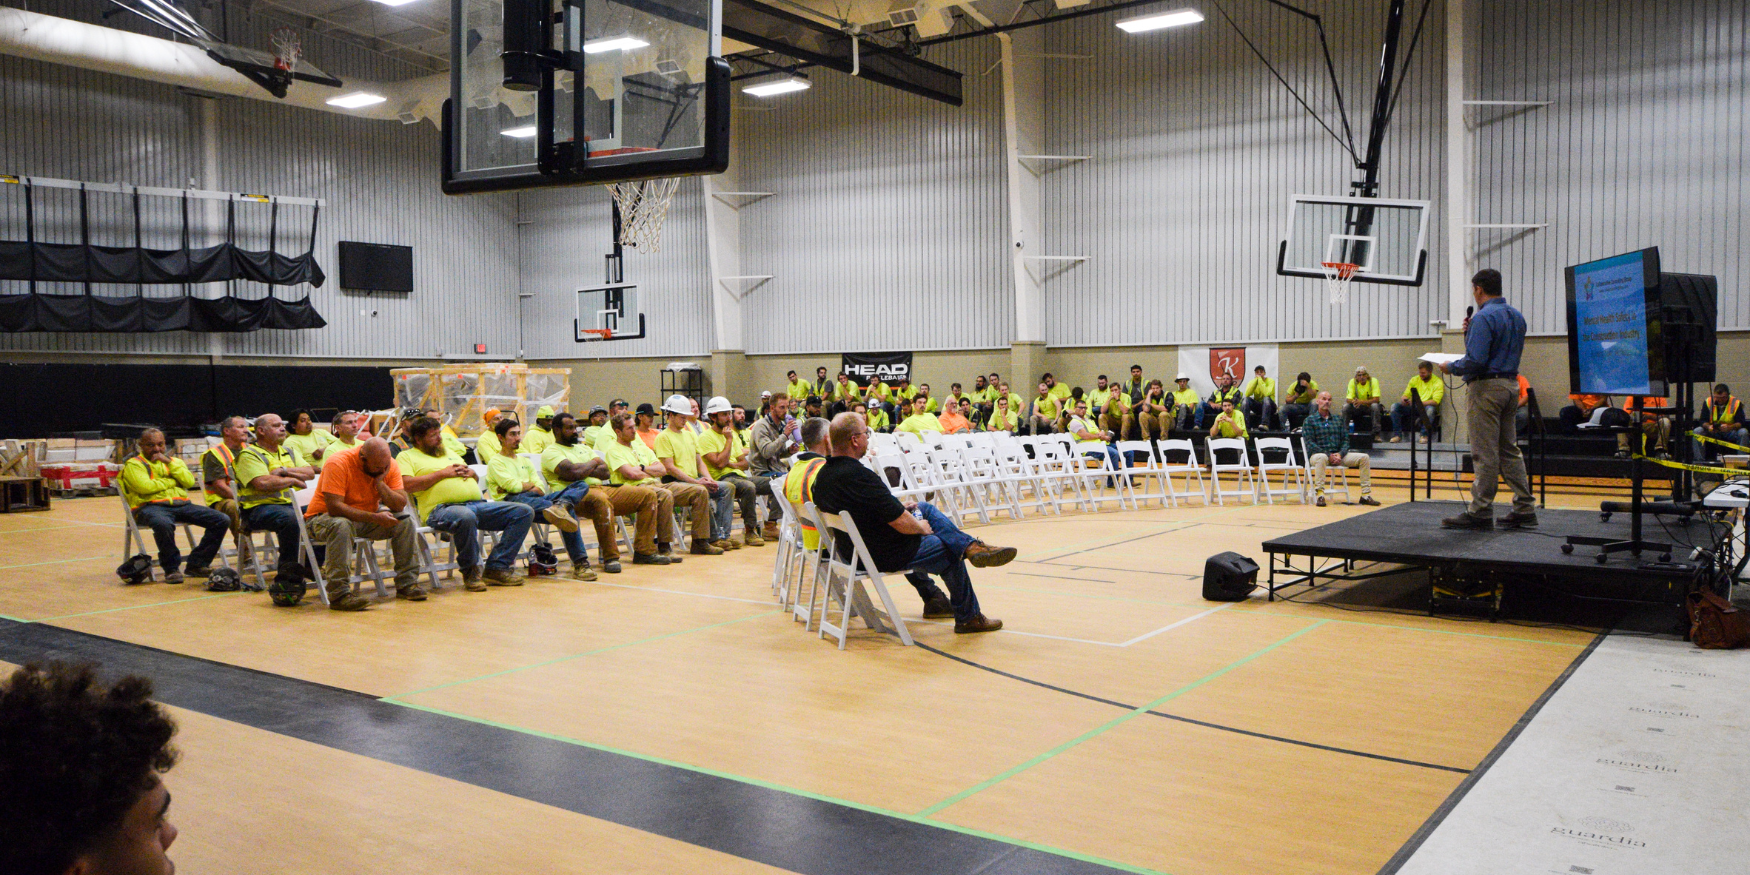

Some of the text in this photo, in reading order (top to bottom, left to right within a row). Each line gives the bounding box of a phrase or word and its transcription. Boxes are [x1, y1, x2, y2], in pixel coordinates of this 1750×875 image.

[844, 364, 908, 376] HEAD
[1216, 357, 1239, 379] K
[1596, 758, 1677, 773] guardia
[1550, 827, 1646, 848] guardia
